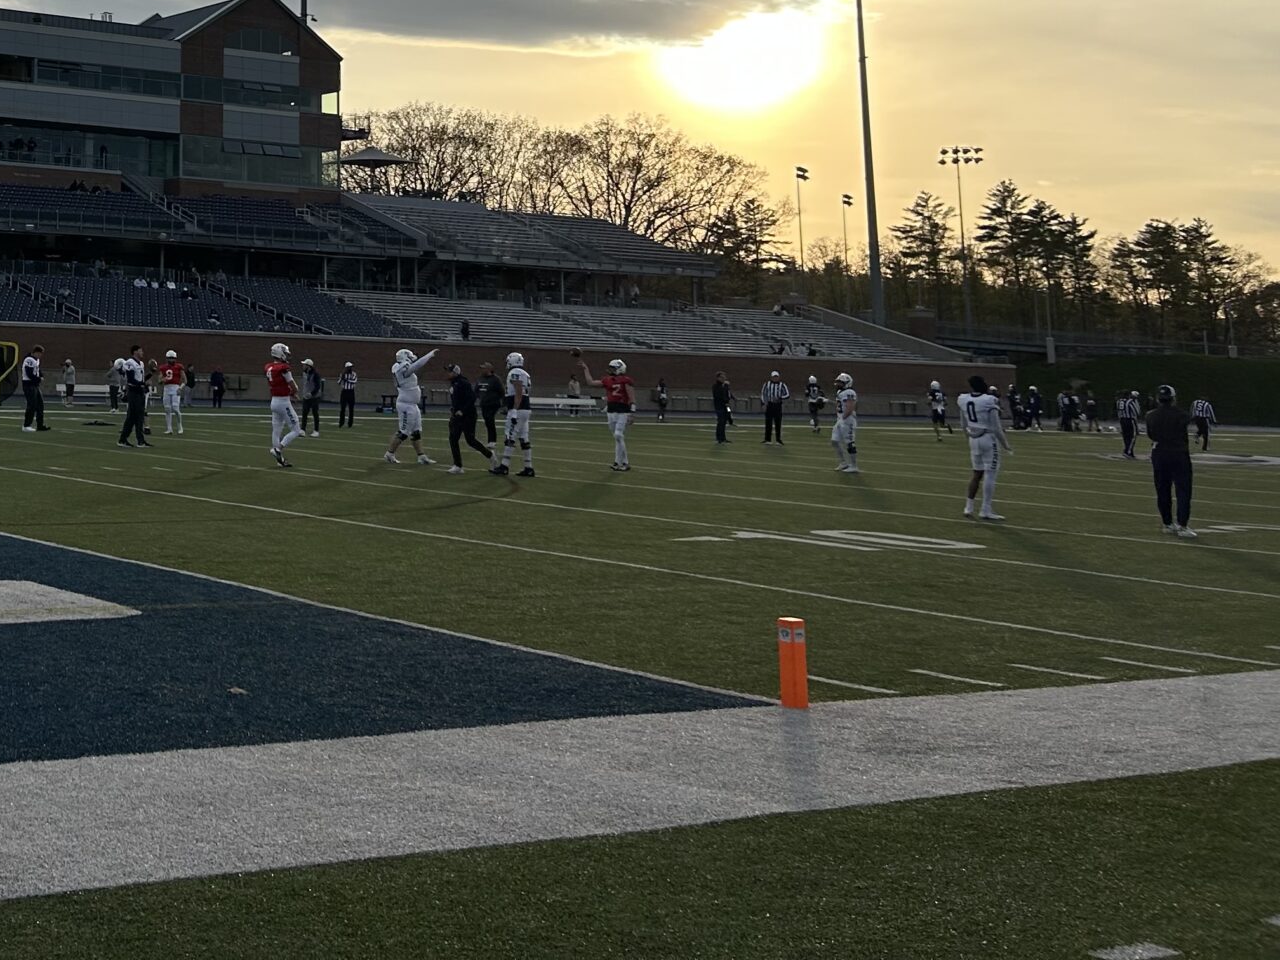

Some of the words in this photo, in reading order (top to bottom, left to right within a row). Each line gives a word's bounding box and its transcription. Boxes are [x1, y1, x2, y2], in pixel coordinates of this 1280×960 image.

[612, 385, 622, 396] 2
[966, 400, 978, 423] 0
[1196, 402, 1203, 411] S
[730, 529, 987, 551] 10
